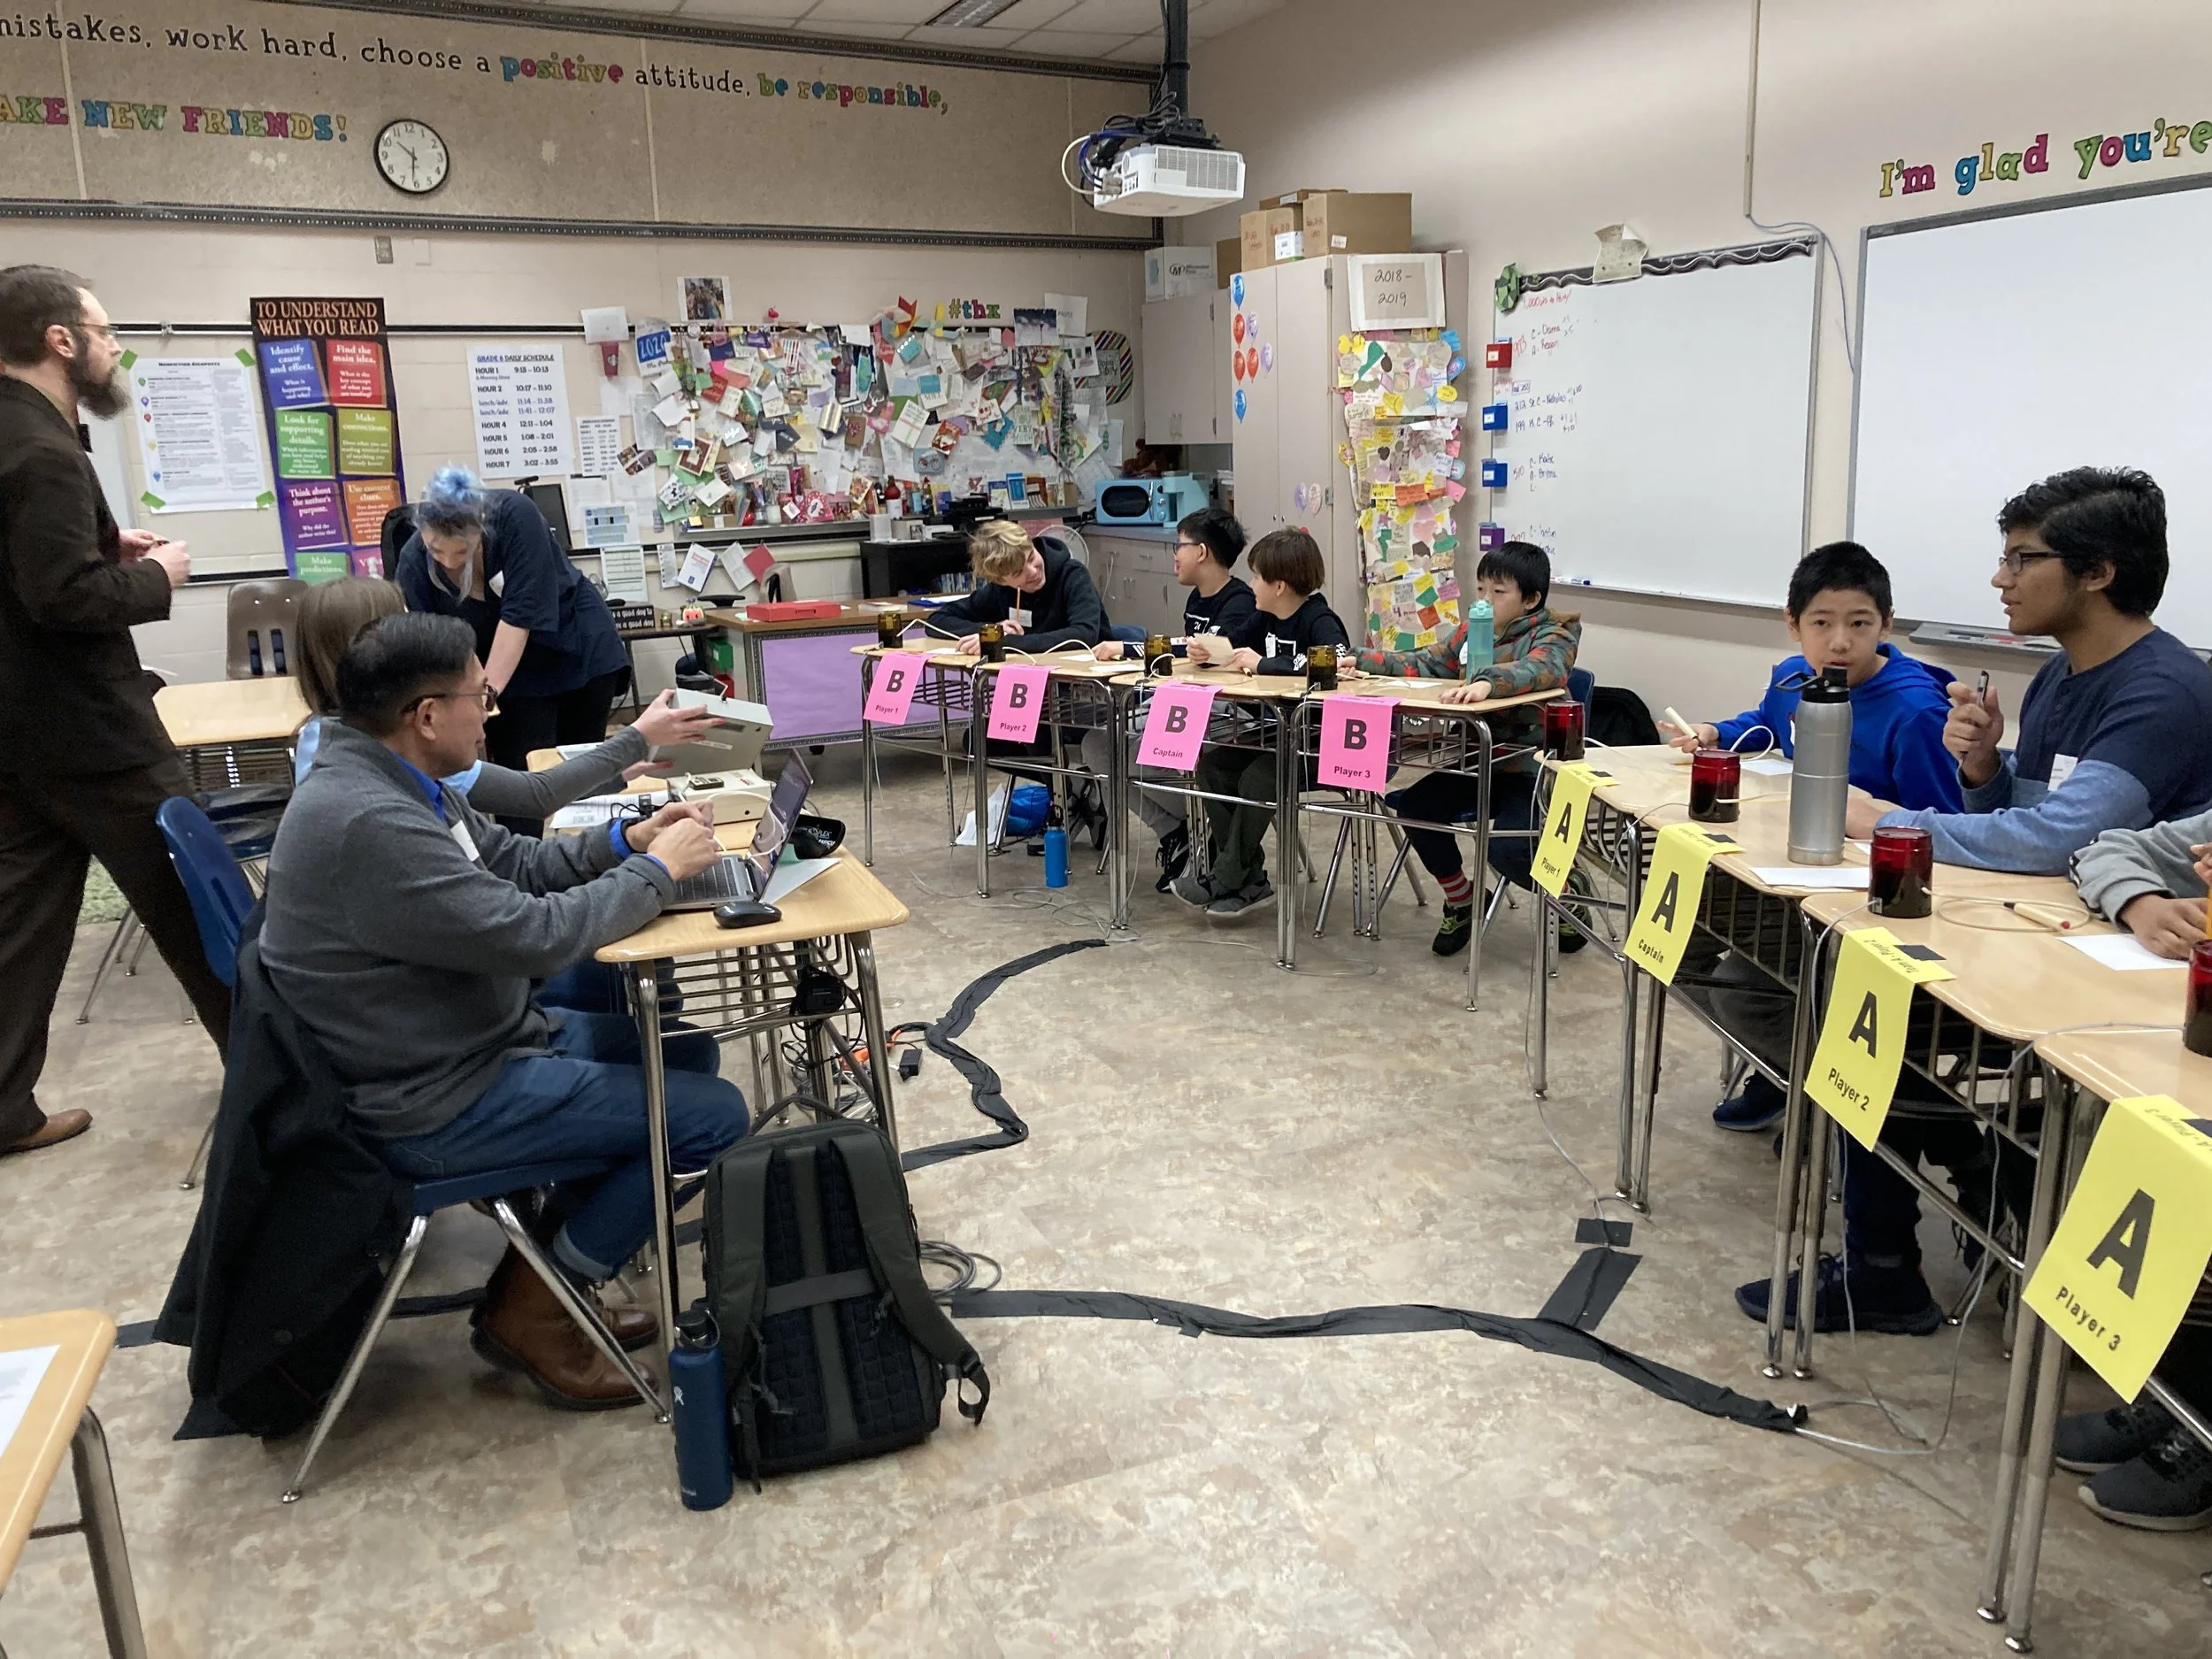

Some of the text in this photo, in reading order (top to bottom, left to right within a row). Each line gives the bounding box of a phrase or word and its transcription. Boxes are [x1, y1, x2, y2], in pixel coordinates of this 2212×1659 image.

[165, 26, 249, 52] work
[261, 28, 348, 62] hard,
[360, 38, 463, 72] choose
[476, 58, 491, 73] a
[499, 52, 624, 84] positive
[634, 64, 751, 97] attitude,
[757, 73, 789, 96] be
[797, 79, 949, 115] responsible,
[81, 99, 168, 132] NEW
[180, 104, 349, 142] FRIENDS!
[1879, 117, 2212, 198] I'm glad you're
[1374, 269, 1403, 283] 2018
[1378, 293, 1408, 306] 2019
[256, 301, 378, 319] TO UNDERSTAND
[949, 298, 1001, 319] #thx
[257, 319, 303, 336] WHAT
[303, 319, 336, 336] YOU
[270, 343, 305, 356] Identify
[336, 344, 372, 355] Find the
[333, 354, 377, 364] main idea.
[269, 362, 313, 374] and effect.
[284, 415, 319, 425] Look for
[355, 412, 375, 422] Make
[280, 426, 325, 436] supporting
[289, 486, 332, 497] Think about
[293, 495, 332, 506] the author's
[298, 506, 328, 518] purpose.
[311, 556, 332, 565] Make
[300, 565, 343, 575] predictions.
[886, 670, 905, 693] B
[1010, 683, 1028, 709] B
[875, 704, 894, 714] Player
[1164, 705, 1189, 733] B
[999, 722, 1021, 733] Player
[1343, 718, 1367, 750] B
[1153, 748, 1183, 758] Captain
[1333, 765, 1371, 779] Player 3
[1555, 802, 1572, 844] A
[1541, 856, 1557, 876] Player
[1651, 871, 1680, 933] A
[1639, 939, 1664, 964] Captain
[1848, 990, 1878, 1059] A
[1828, 1067, 1870, 1112] Player 2
[2086, 1187, 2156, 1301] A
[2055, 1286, 2122, 1352] Player 3
